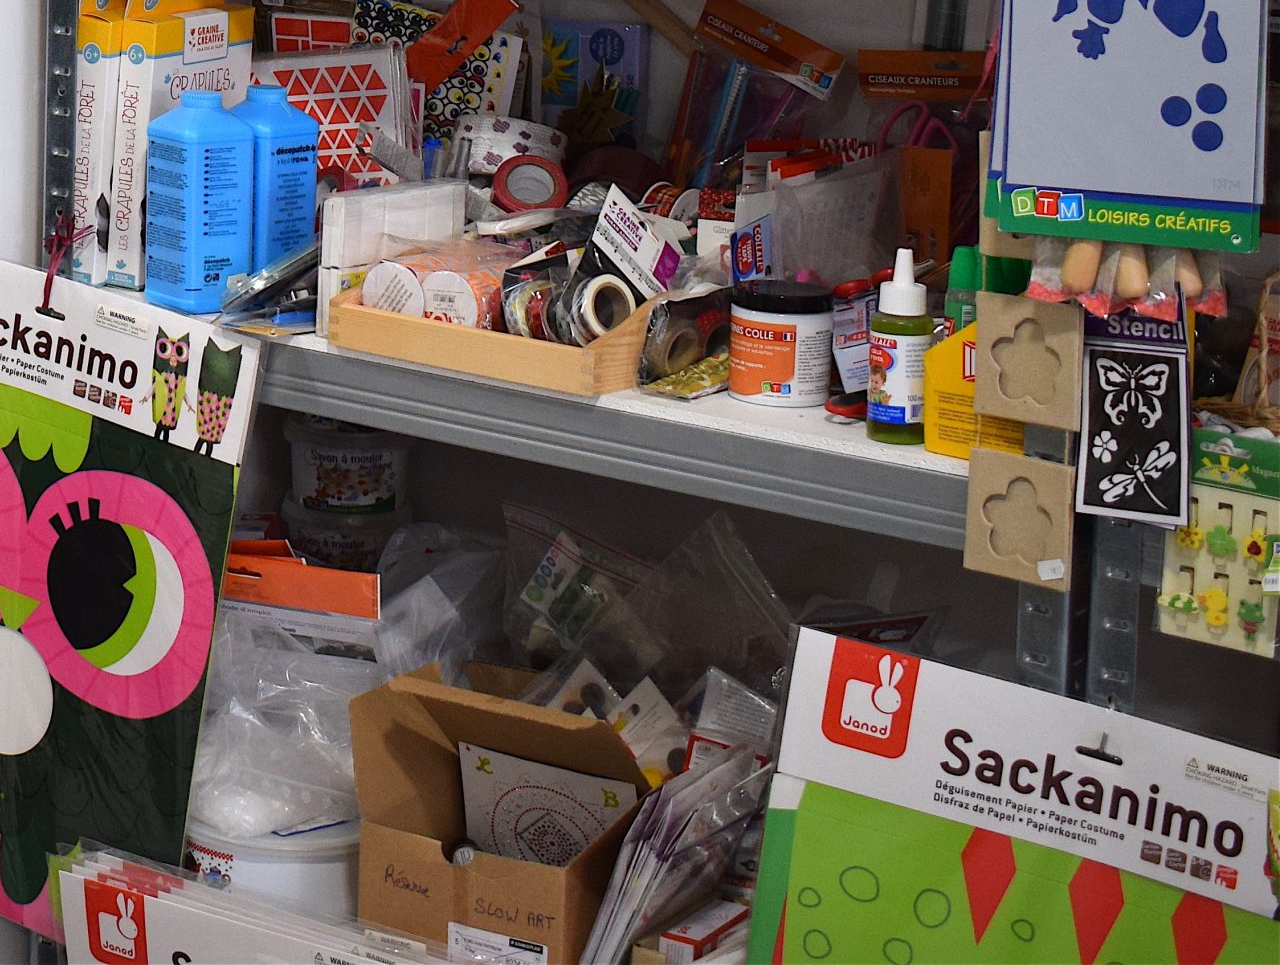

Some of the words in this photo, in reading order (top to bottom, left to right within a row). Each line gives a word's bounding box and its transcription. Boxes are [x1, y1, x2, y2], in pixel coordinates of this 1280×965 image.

[197, 24, 219, 36] GRAINE
[197, 32, 224, 45] CREATIVE
[86, 49, 100, 59] 6+
[130, 49, 144, 59] 6+
[868, 74, 906, 84] CISEAUX
[907, 76, 959, 86] CRANTEURS
[78, 81, 95, 128] FORÊT
[122, 81, 140, 129] FORÊT
[126, 129, 136, 140] LA
[125, 141, 134, 154] DE
[276, 145, 311, 155] décopatch
[115, 157, 134, 232] CRAPULES
[1016, 194, 1080, 220] DTM
[1088, 208, 1150, 226] LOISIRS
[1155, 211, 1232, 234] CRÉATIFS
[119, 233, 128, 251] LES
[754, 224, 764, 274] COLLALL
[109, 310, 136, 324] WARNING
[1107, 313, 1184, 341] Stencil
[745, 328, 775, 341] COLLE
[1, 363, 48, 386] Papierkostüm
[16, 356, 36, 372] Paper
[36, 364, 66, 381] Costume
[907, 394, 918, 402] 100
[842, 715, 889, 737] Janod
[1206, 763, 1250, 783] WARNING
[939, 727, 1245, 858] Sackanimo
[933, 792, 970, 811] Disfraz
[971, 802, 985, 815] de
[986, 807, 1016, 824] Papel
[1025, 816, 1098, 847] Papierkostüm
[935, 779, 1004, 806] Déguisement
[1004, 798, 1038, 817] Papier
[1048, 810, 1079, 828] Paper
[1080, 819, 1125, 842] Costume
[474, 897, 520, 924] SLOW
[527, 912, 556, 930] ART
[103, 939, 134, 958] Janod
